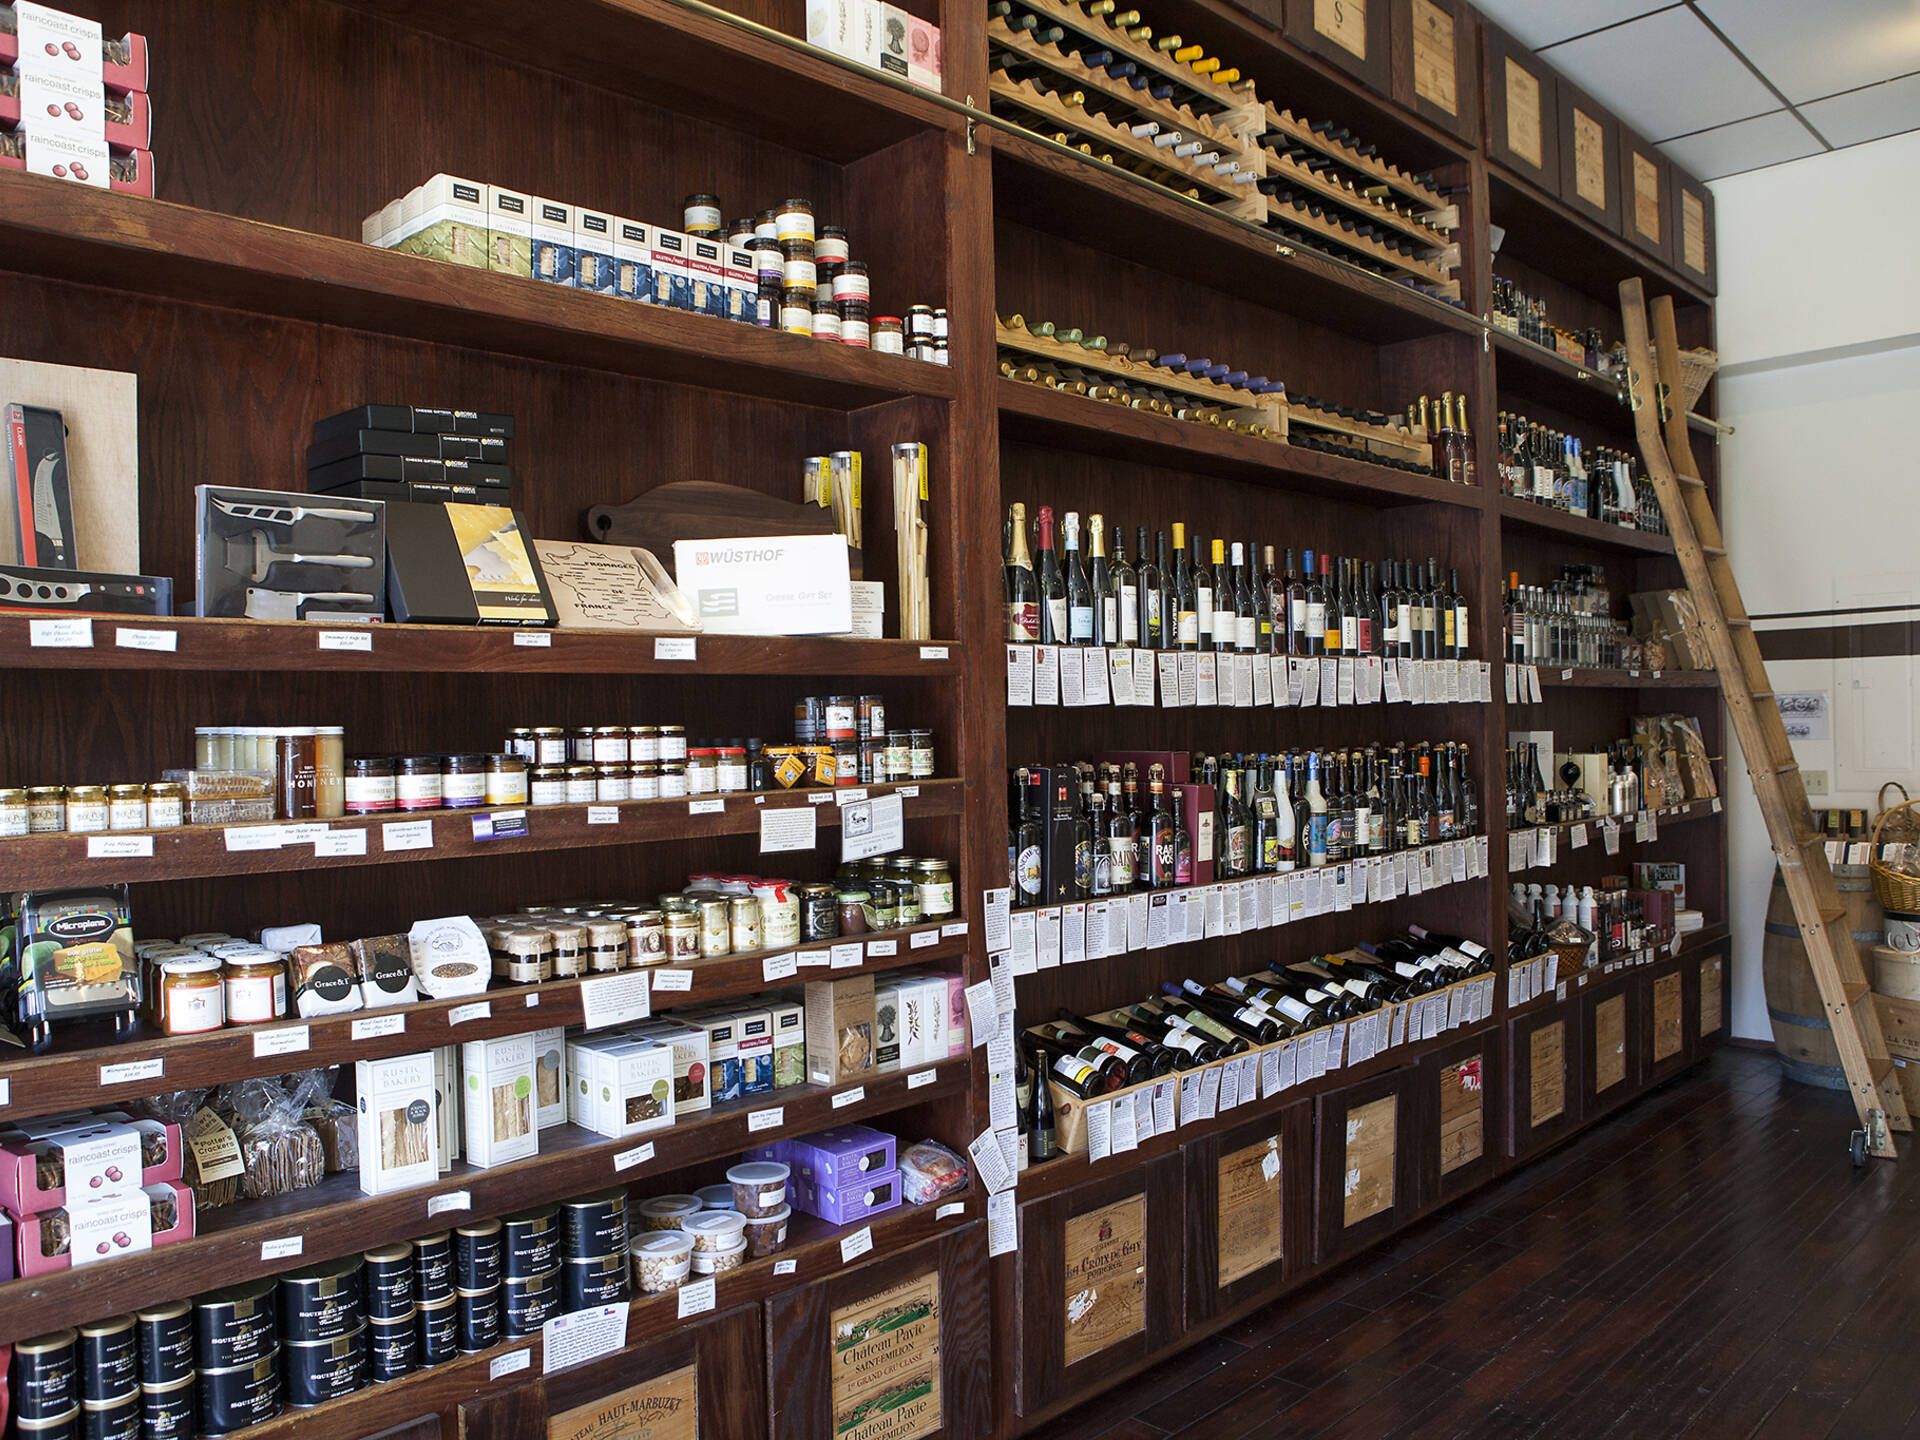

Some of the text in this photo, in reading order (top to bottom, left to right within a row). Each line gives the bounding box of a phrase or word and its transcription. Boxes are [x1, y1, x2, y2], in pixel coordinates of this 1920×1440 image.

[24, 73, 101, 100] raincoast crisps
[30, 134, 106, 158] raincoast crisps
[584, 561, 635, 570] FROMAGES
[709, 549, 784, 564] WÜSTHOF
[56, 919, 105, 932] Microplane
[198, 1141, 235, 1155] Crackers
[200, 1134, 233, 1148] Potter's
[68, 1142, 139, 1165] raincoast crisps
[74, 1208, 148, 1231] raincoast crisps
[843, 1322, 926, 1366] Château Pavie
[856, 1369, 882, 1387] GRAND
[598, 1397, 682, 1426] HAUT-MARBUZET
[897, 1399, 928, 1422] Pavie
